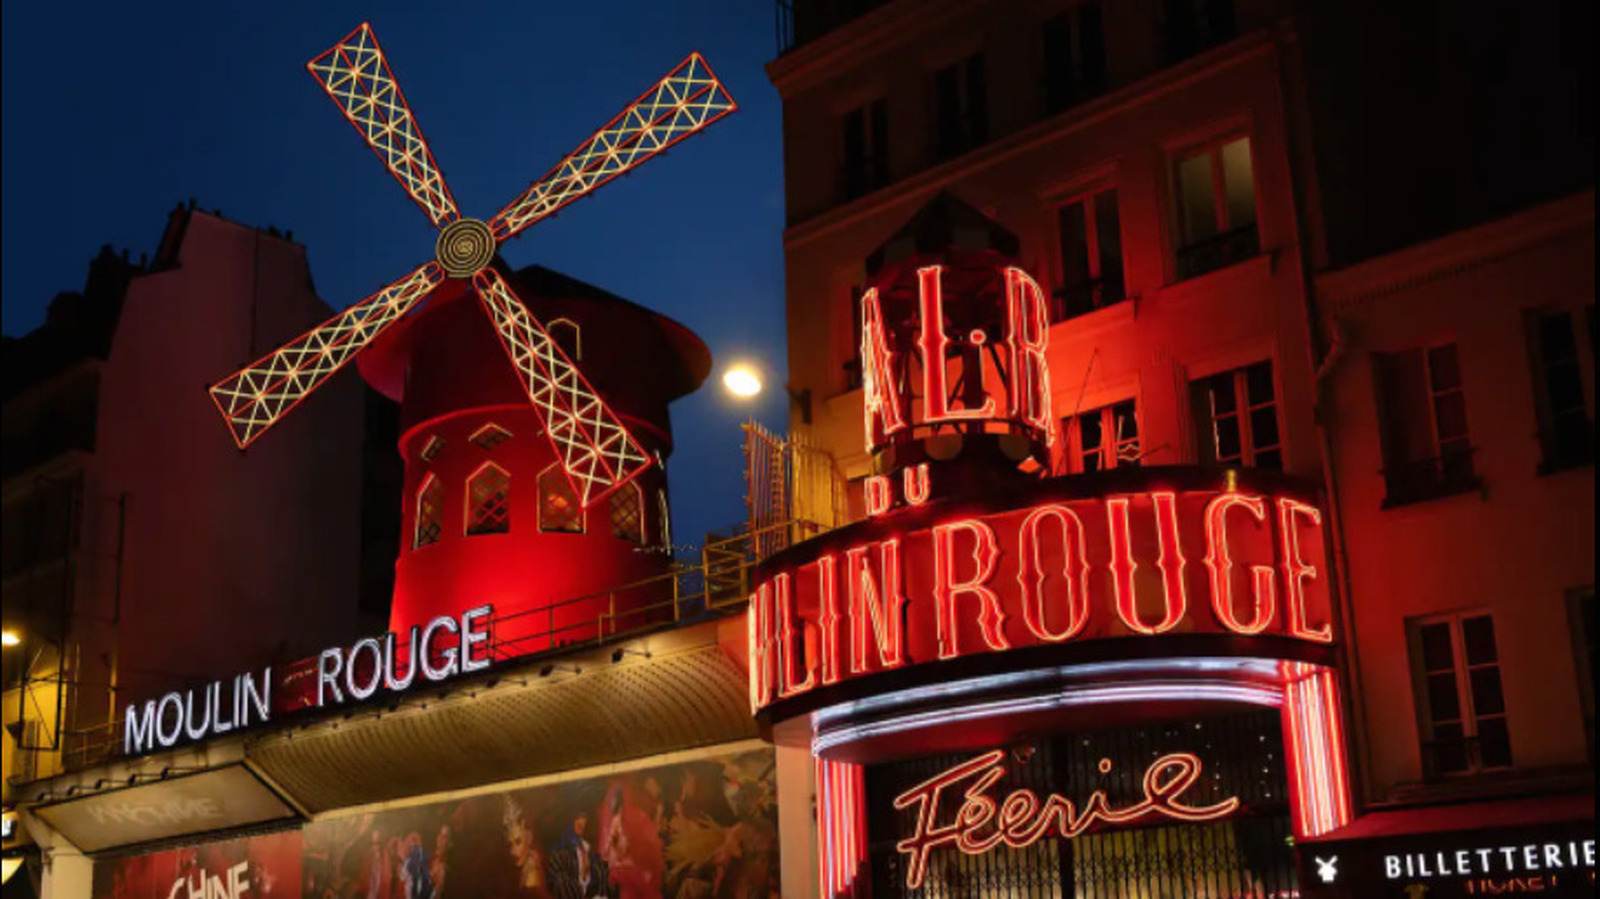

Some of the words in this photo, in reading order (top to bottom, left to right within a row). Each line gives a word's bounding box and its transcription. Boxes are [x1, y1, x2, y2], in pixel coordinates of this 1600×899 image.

[864, 463, 931, 516] DU
[932, 492, 1333, 660] ROUGE
[124, 666, 271, 755] MOULIN
[316, 604, 494, 707] ROUGE
[1384, 839, 1596, 879] BILLETTERIE
